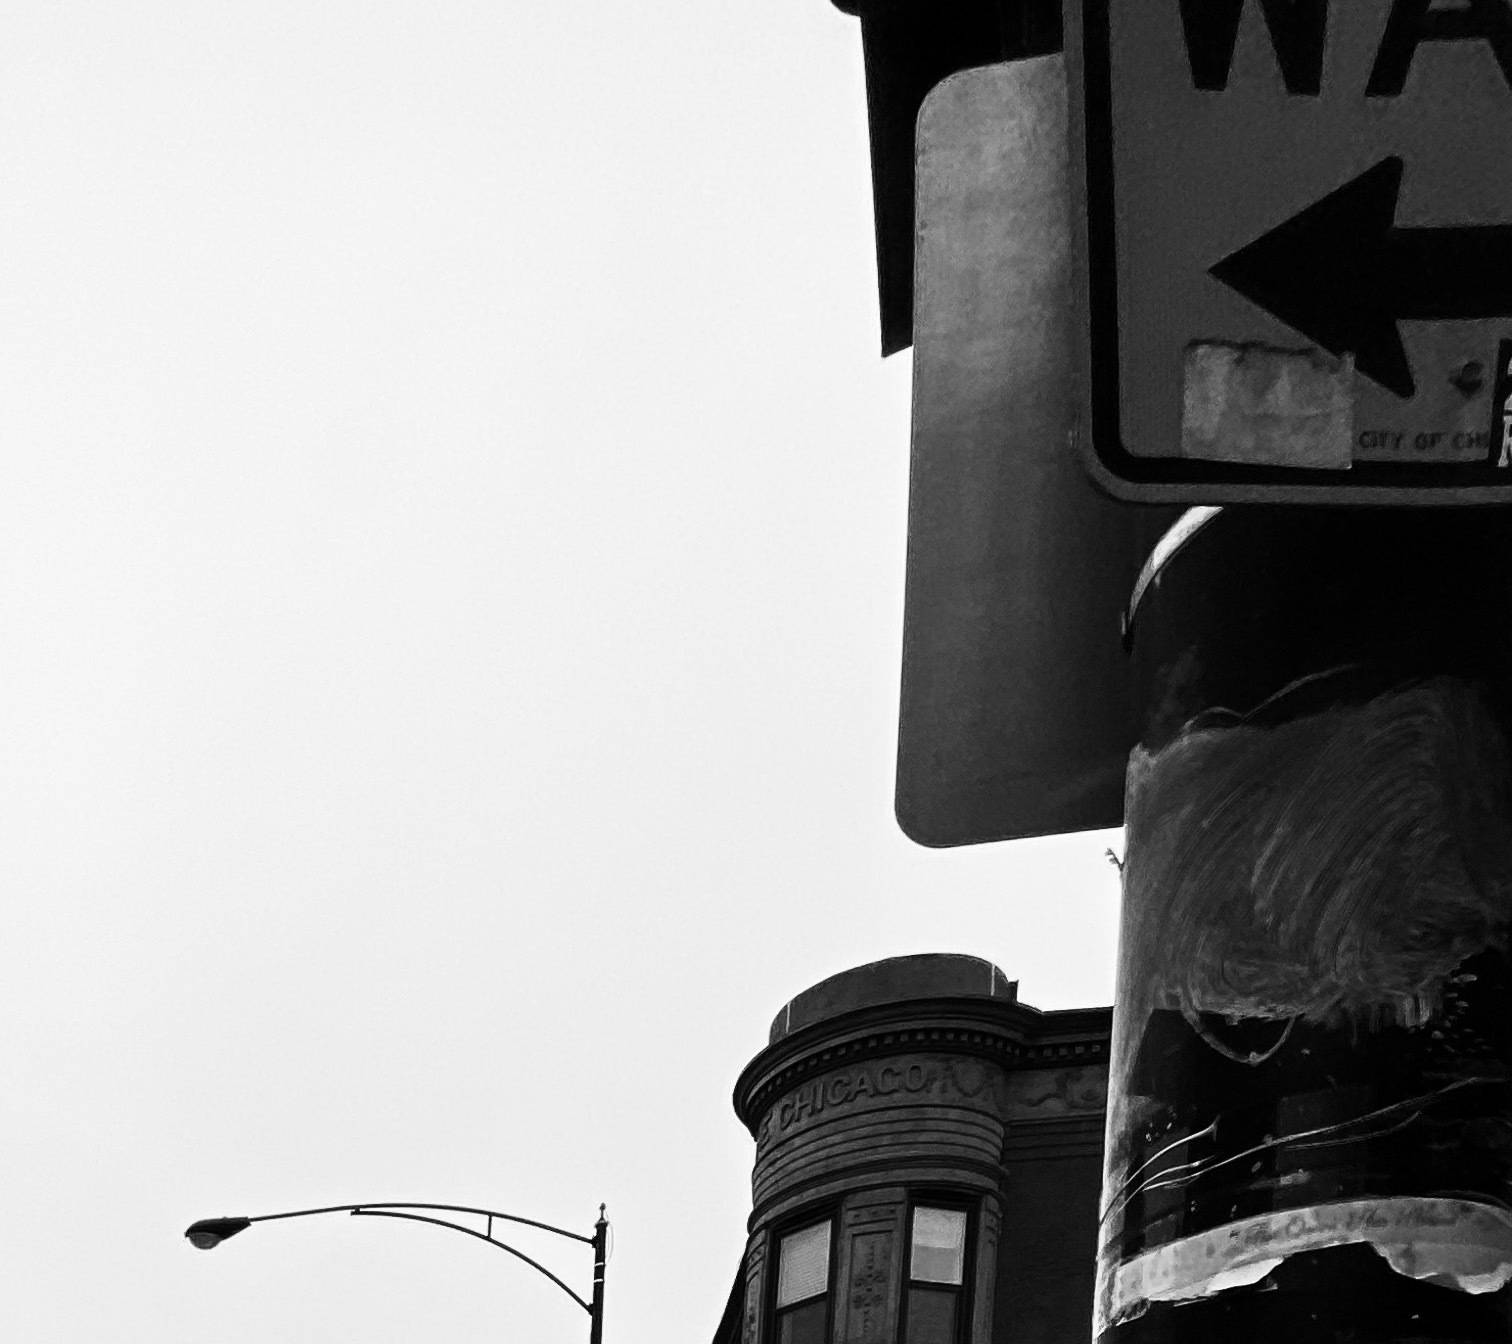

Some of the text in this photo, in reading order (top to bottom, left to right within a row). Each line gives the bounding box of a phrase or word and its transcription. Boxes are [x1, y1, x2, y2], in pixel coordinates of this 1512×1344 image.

[1358, 430, 1403, 449] CITY
[1414, 432, 1445, 450] OF
[779, 1064, 927, 1131] CHICAGO
